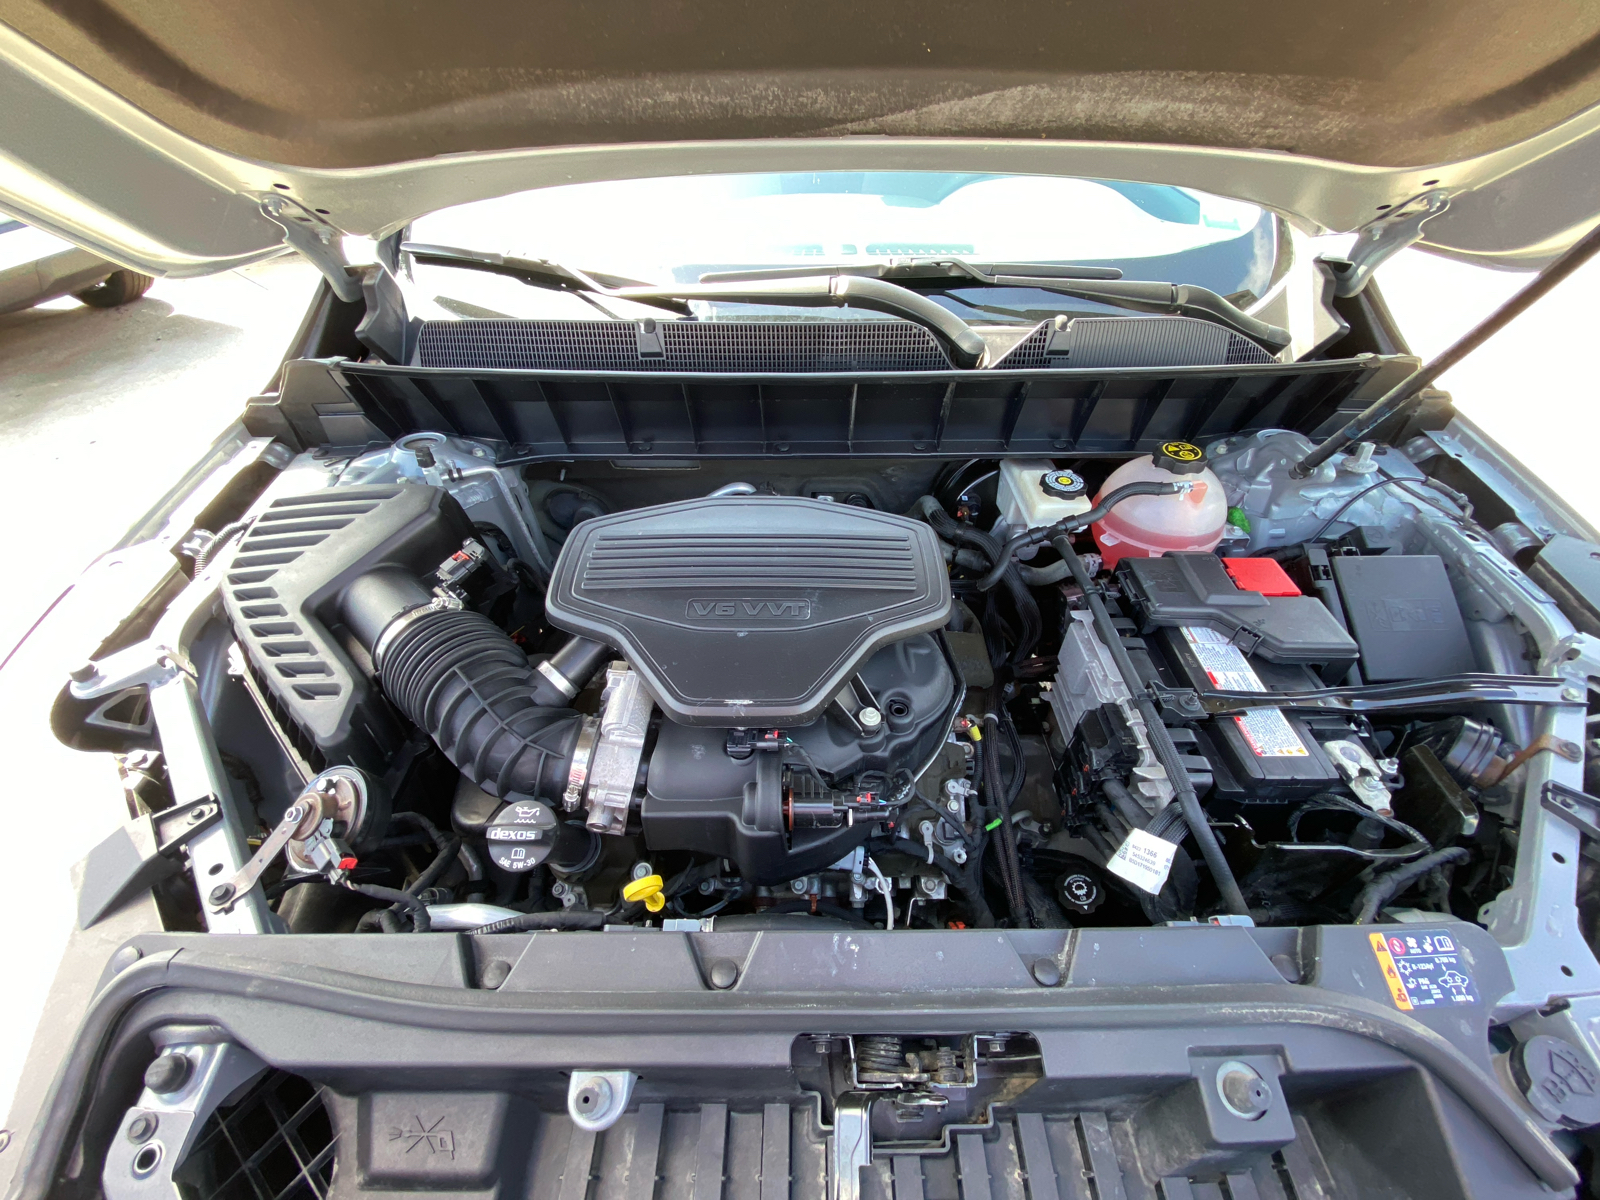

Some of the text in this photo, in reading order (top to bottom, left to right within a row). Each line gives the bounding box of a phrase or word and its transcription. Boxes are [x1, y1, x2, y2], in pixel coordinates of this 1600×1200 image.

[693, 602, 805, 616] V6 VVT
[490, 827, 536, 840] dexos
[1143, 848, 1158, 858] 1366
[499, 857, 536, 869] SAE 5W-30
